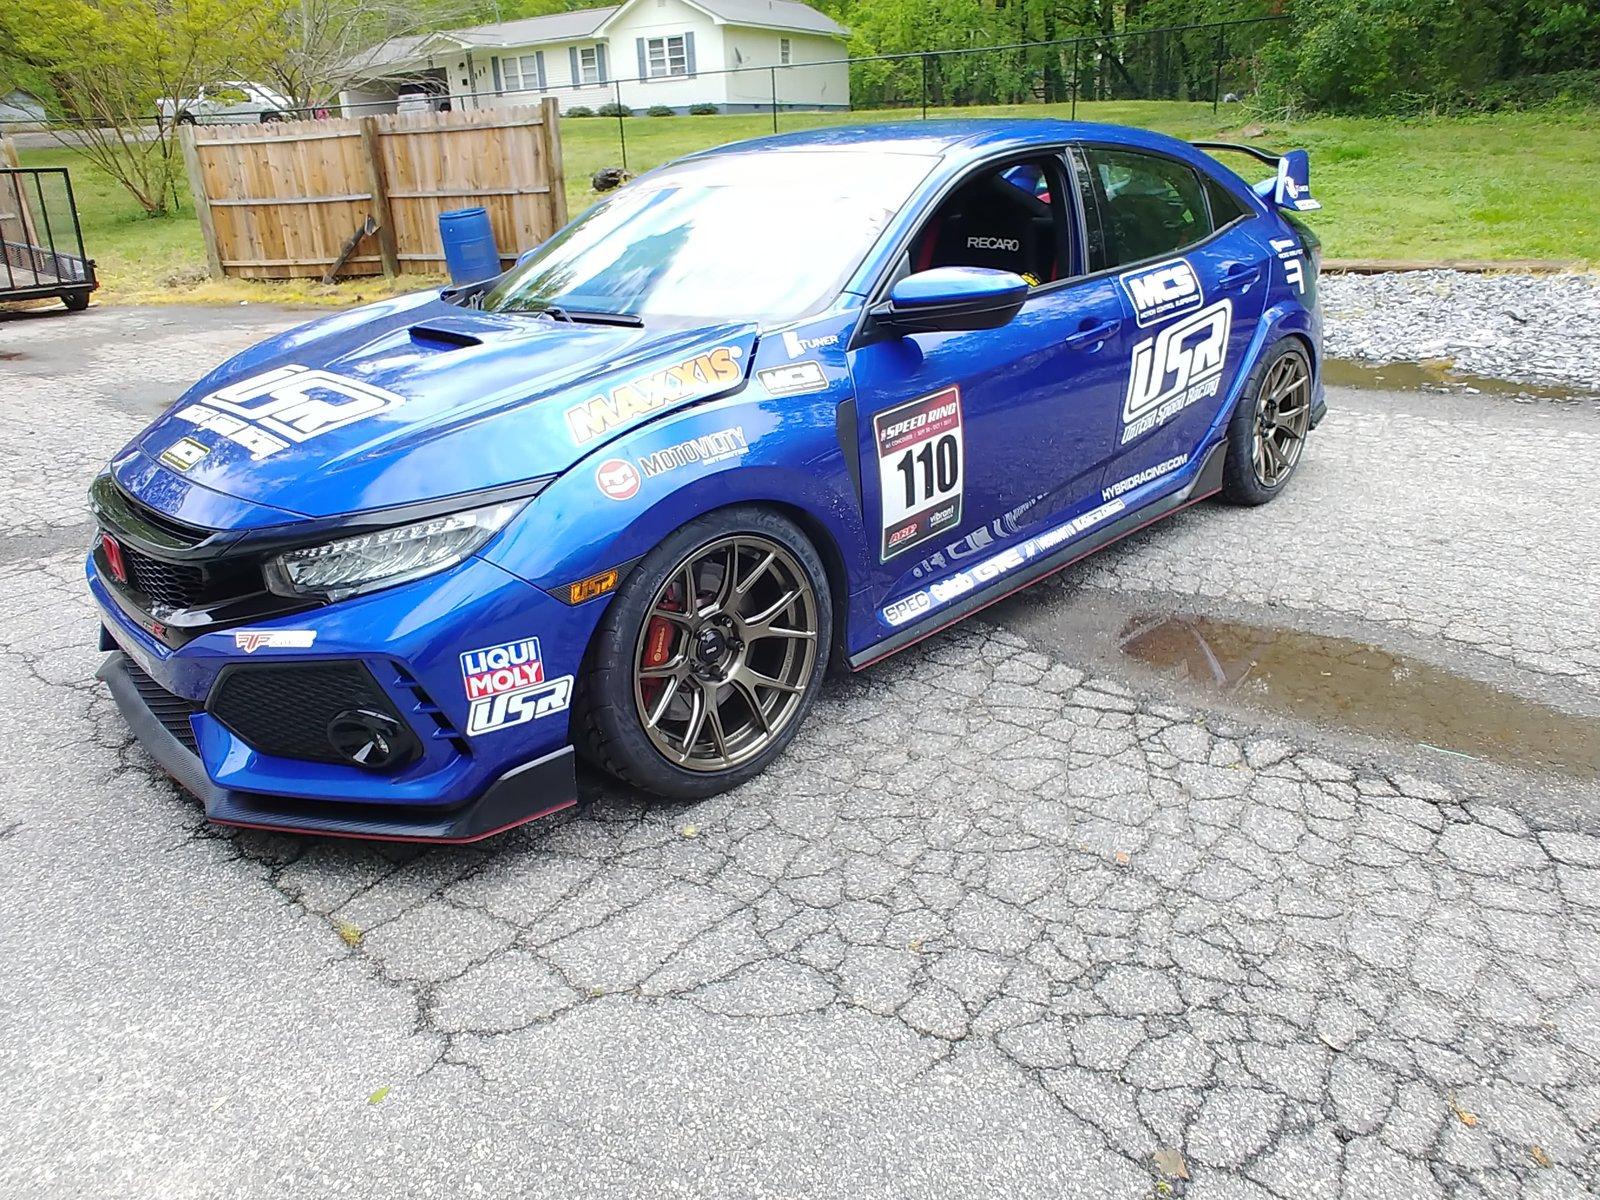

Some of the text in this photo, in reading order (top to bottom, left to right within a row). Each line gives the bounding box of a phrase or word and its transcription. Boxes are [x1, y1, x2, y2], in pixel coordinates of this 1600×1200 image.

[967, 236, 1020, 252] RECARO
[1127, 264, 1196, 311] MCS
[567, 347, 740, 444] MAXXIS
[926, 402, 957, 424] RING
[640, 425, 748, 477] MOTOVICITY
[897, 434, 959, 509] 110
[1102, 453, 1189, 502] HYBRIDRACING.COM
[885, 592, 931, 622] SPEC
[465, 641, 537, 676] LIQUI
[468, 661, 541, 698] MOLY
